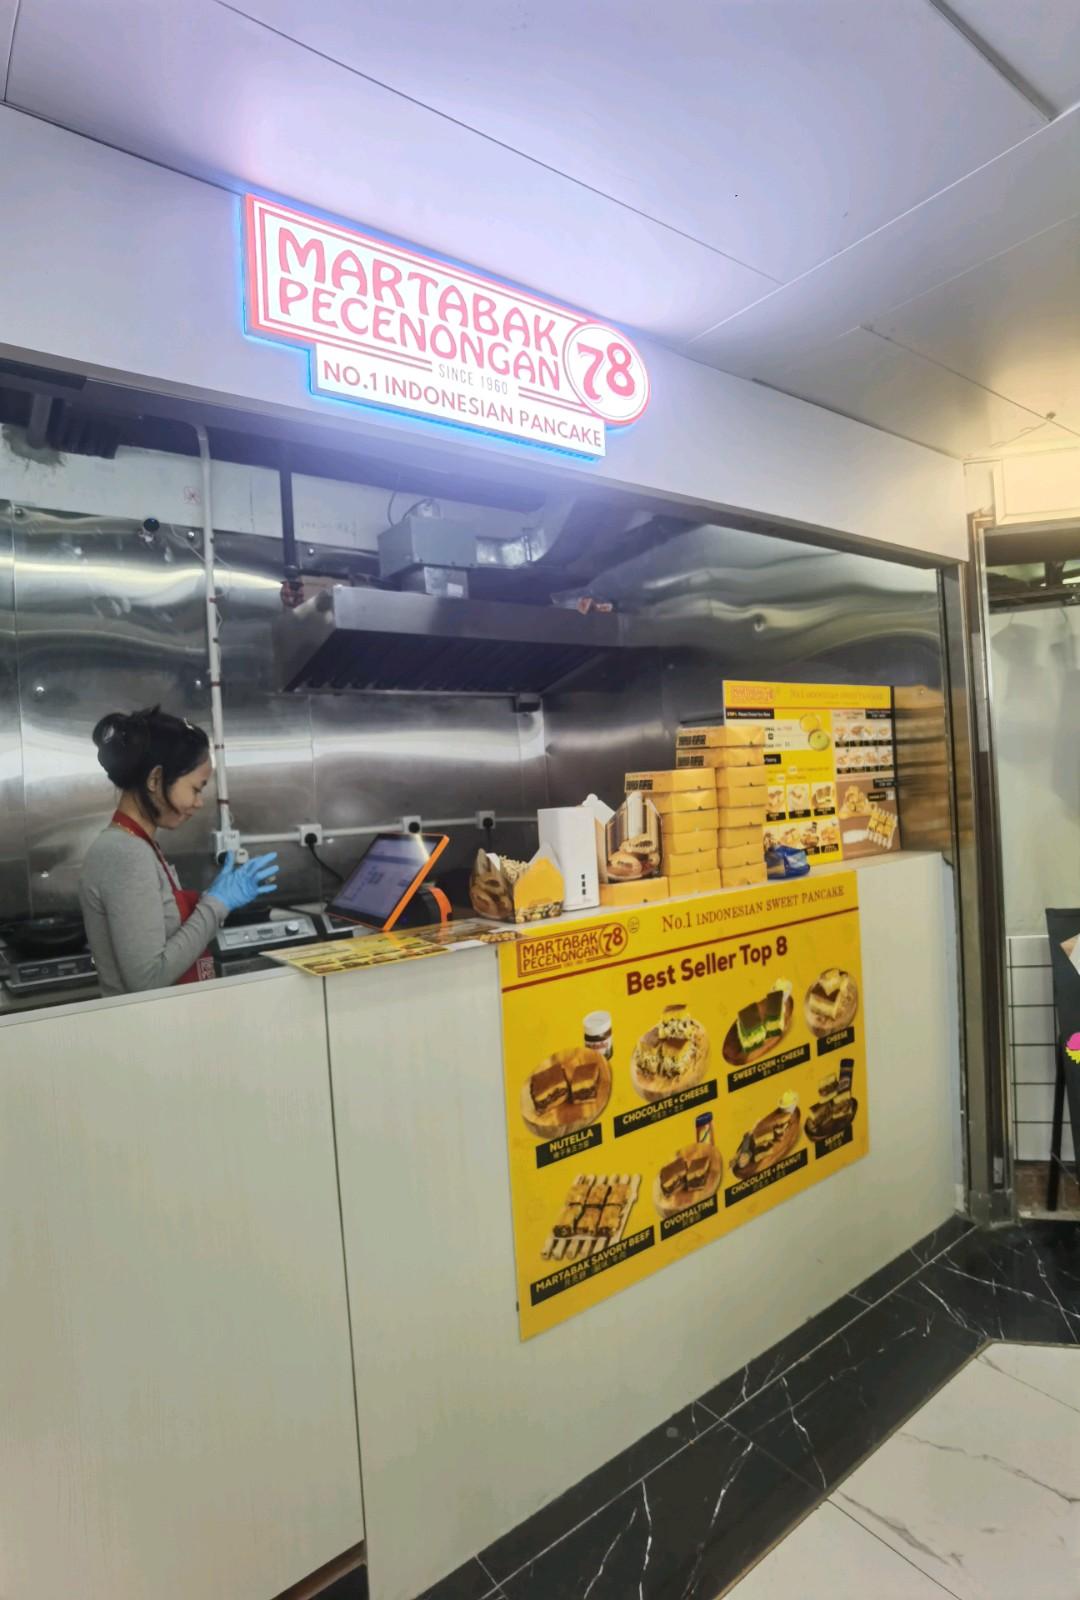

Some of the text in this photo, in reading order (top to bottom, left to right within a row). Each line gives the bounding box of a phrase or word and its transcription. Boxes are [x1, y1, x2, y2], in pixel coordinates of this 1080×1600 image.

[279, 227, 559, 357] MARTABAK
[279, 278, 561, 392] PECENONGAN
[438, 363, 509, 396] SINCE 1960
[576, 341, 637, 401] 78
[323, 360, 602, 449] NO.1 INDONESIAN PANCAKE
[662, 912, 692, 933] No.1
[696, 901, 763, 926] INDONESIAN
[766, 894, 798, 912] SWEET
[801, 885, 845, 905] PANCAKE
[522, 931, 598, 959] MARTABAK
[523, 945, 599, 971] PECENONGAN
[603, 927, 623, 953] 78
[626, 935, 788, 996] Best Seller Top 8
[732, 1066, 757, 1082] SWEET
[622, 1098, 674, 1125] CHOCOLATE
[679, 1083, 710, 1103] CHEESE
[550, 1128, 594, 1152] NUTELLA
[731, 1171, 772, 1196] CHOCOLATE
[663, 1198, 715, 1230] OVOMALTINE
[535, 1261, 591, 1293] MARTABAK
[591, 1241, 628, 1265] SAVORY
[628, 1229, 651, 1247] BEEF
